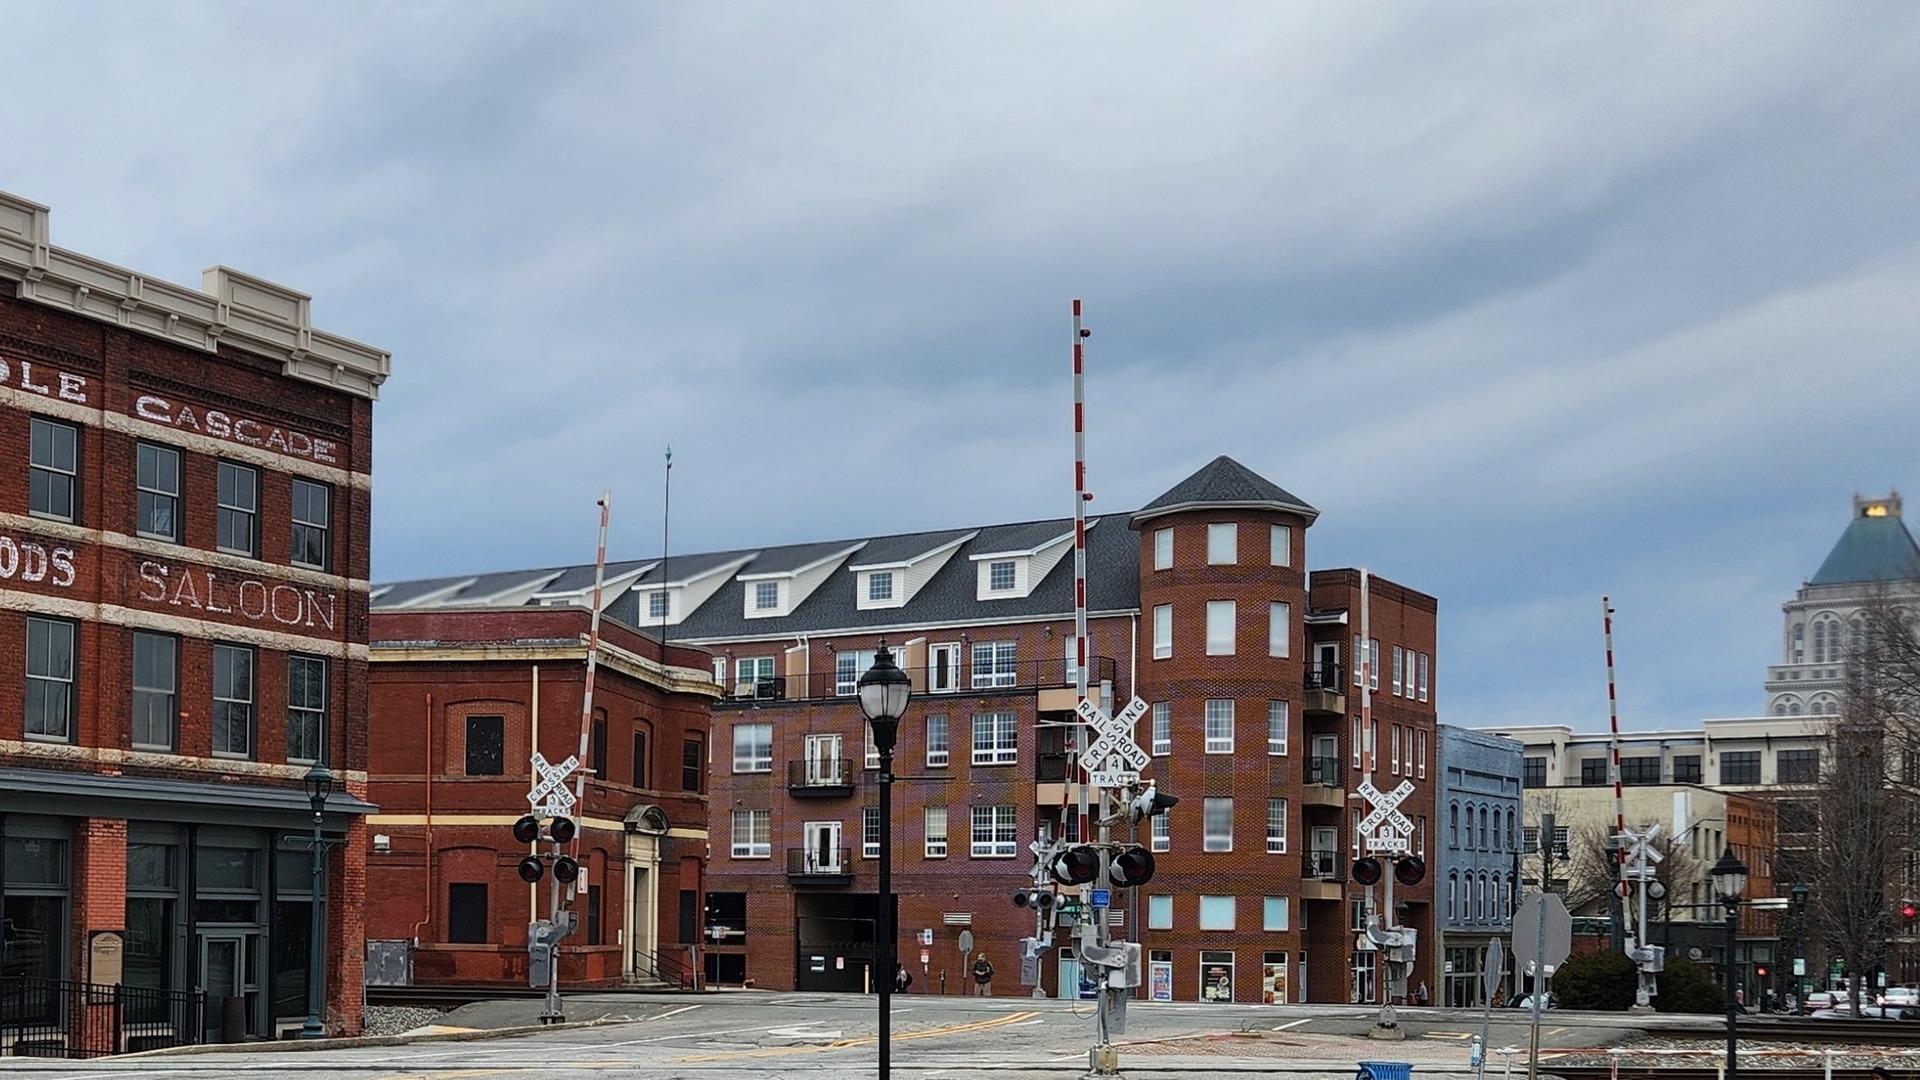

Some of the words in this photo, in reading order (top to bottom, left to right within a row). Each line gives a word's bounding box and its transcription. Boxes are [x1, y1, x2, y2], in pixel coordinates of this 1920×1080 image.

[136, 395, 337, 463] CASCADE
[139, 561, 336, 631] SALOON
[1083, 700, 1145, 769] CROSSING
[530, 758, 577, 802] CROSSING
[1092, 774, 1138, 784] TRACS
[1111, 758, 1119, 769] 4
[1360, 783, 1412, 833] CROSSING
[1383, 828, 1390, 838] 3
